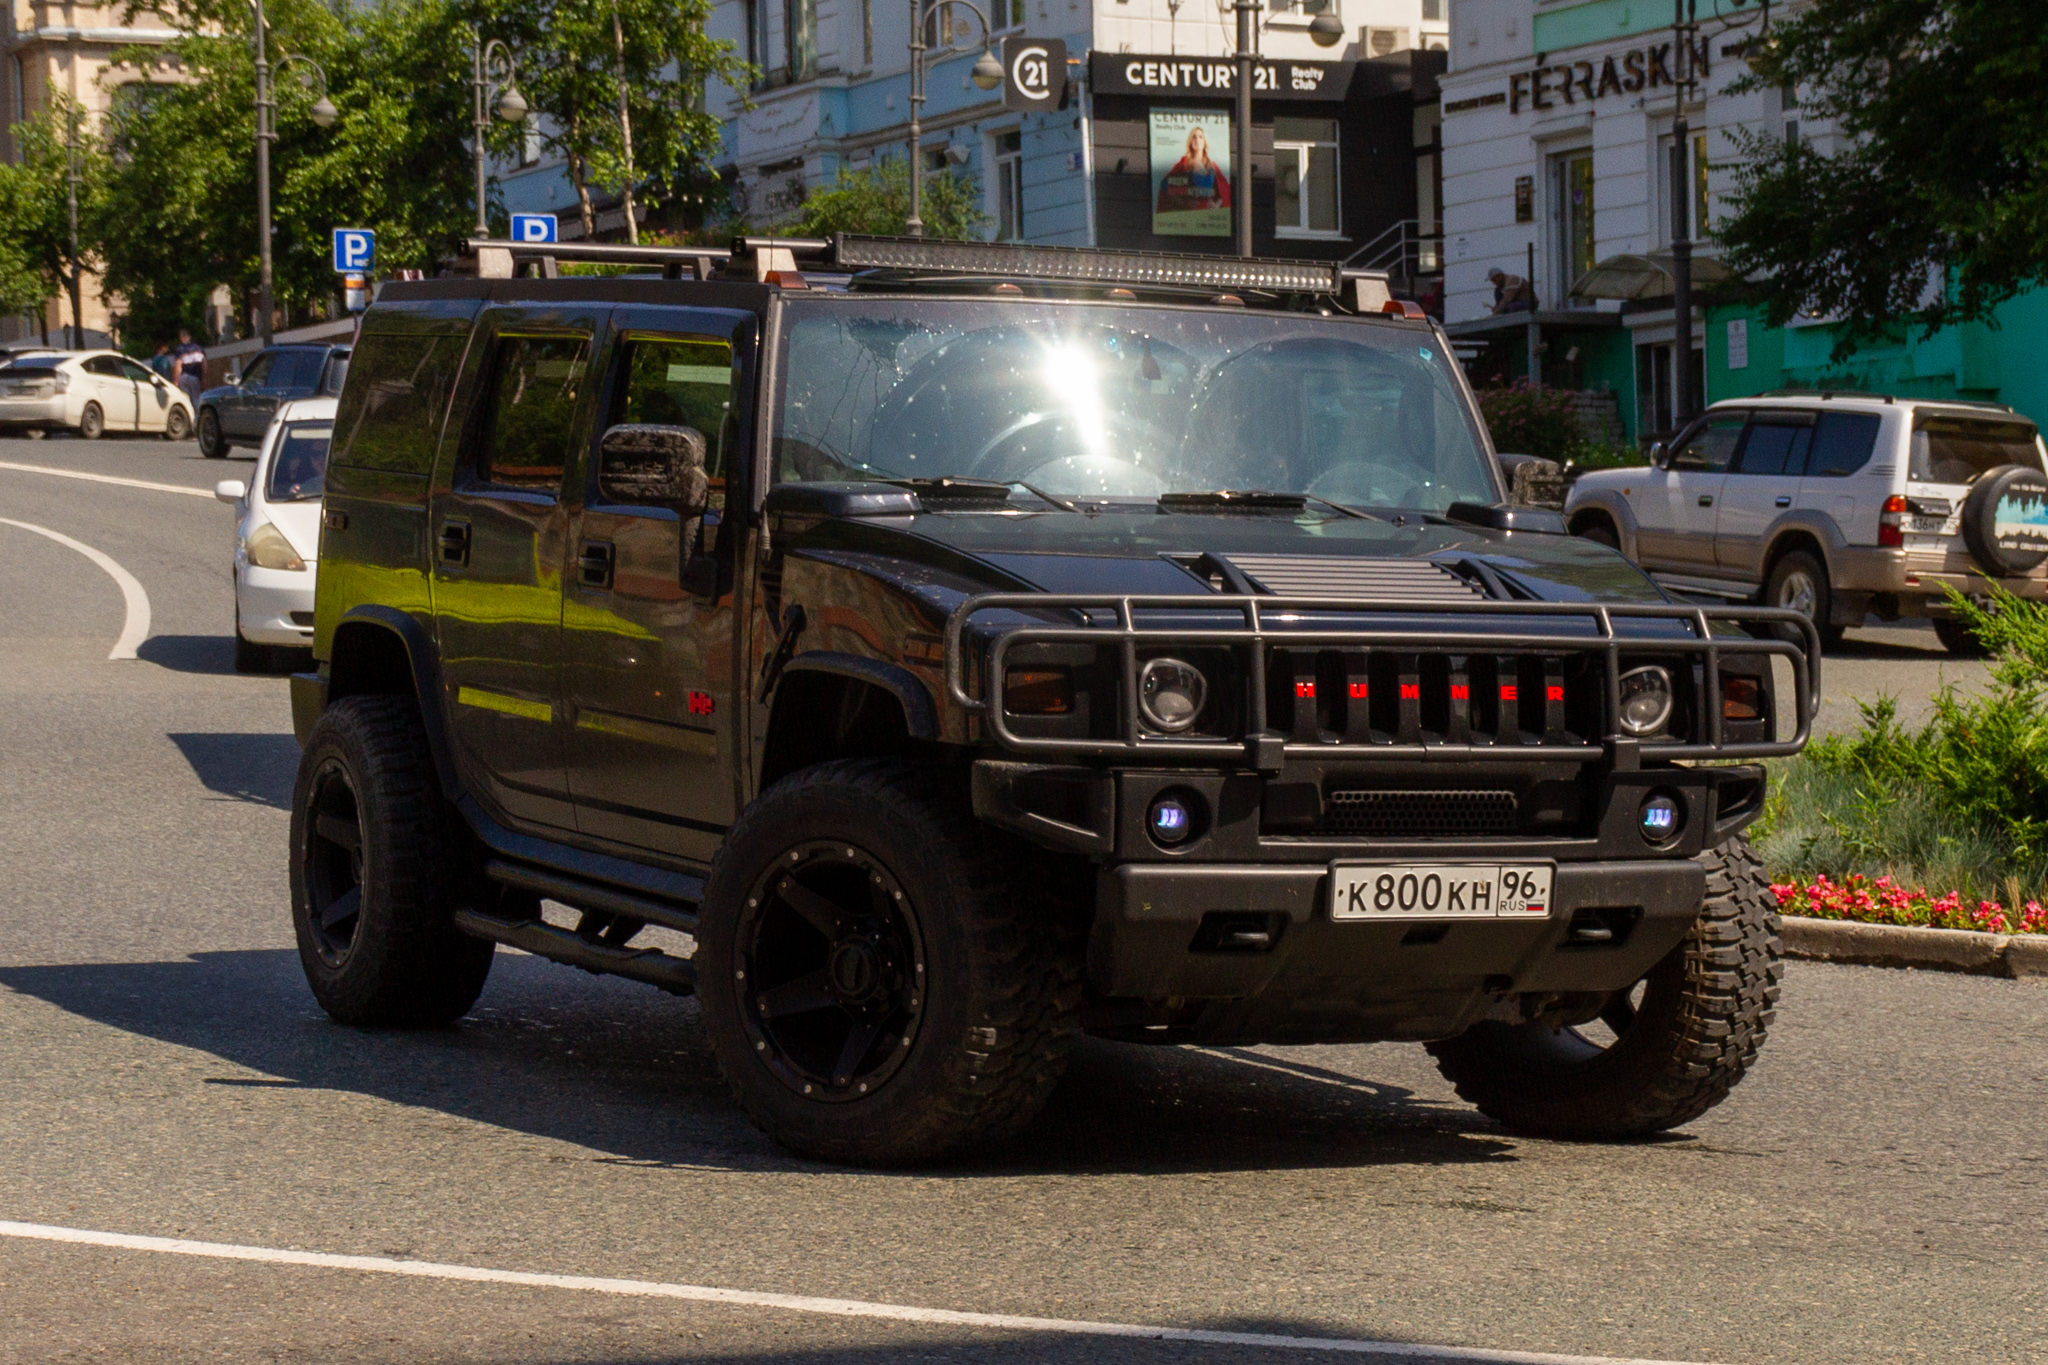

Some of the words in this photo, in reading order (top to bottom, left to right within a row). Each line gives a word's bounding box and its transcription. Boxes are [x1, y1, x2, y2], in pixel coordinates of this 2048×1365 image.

[1024, 60, 1048, 87] 21
[1253, 66, 1277, 90] 21
[1291, 65, 1325, 81] Realty
[1291, 79, 1317, 91] Club
[1509, 35, 1710, 116] FÉRRASKN
[345, 233, 368, 267] P
[1295, 681, 1564, 701] HUMMER
[1503, 870, 1536, 900] 96
[1500, 899, 1526, 911] RUS
